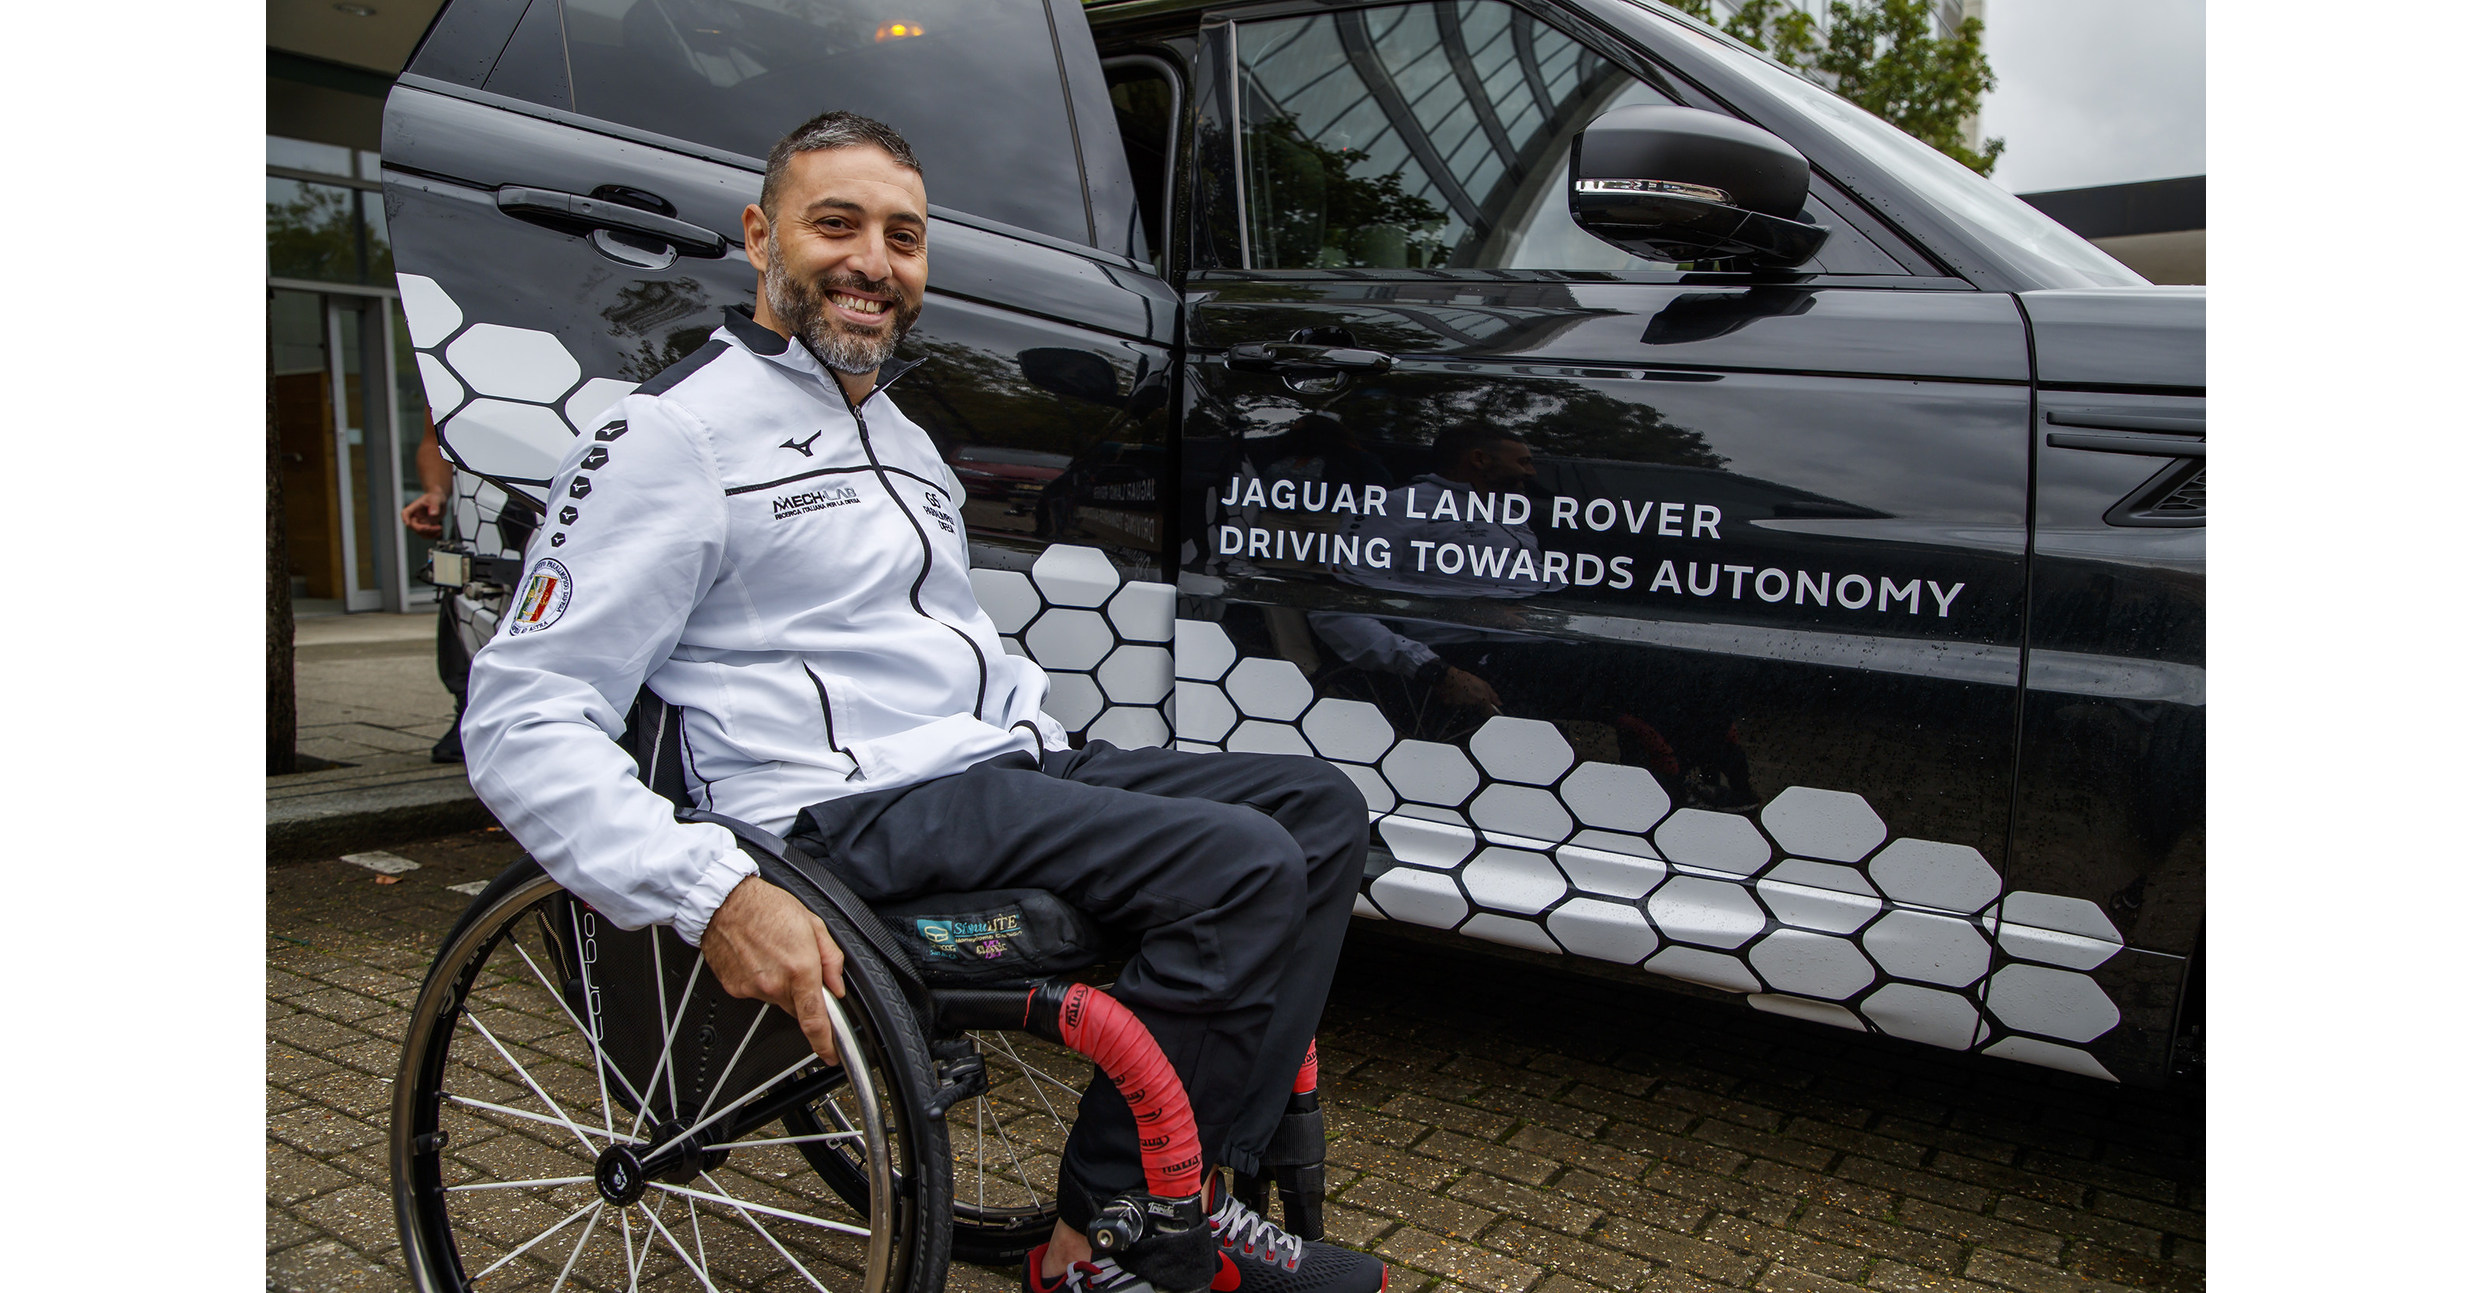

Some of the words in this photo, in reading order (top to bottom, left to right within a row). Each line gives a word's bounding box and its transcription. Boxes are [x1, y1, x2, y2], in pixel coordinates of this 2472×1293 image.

[925, 491, 941, 509] GS
[1221, 476, 1387, 517] JAGUAR
[1406, 487, 1531, 525] LAND
[1551, 496, 1721, 540] ROVER
[1219, 525, 1392, 569] DRIVING
[1410, 540, 1634, 589] TOWARDS
[1649, 560, 1965, 617] AUTONOMY
